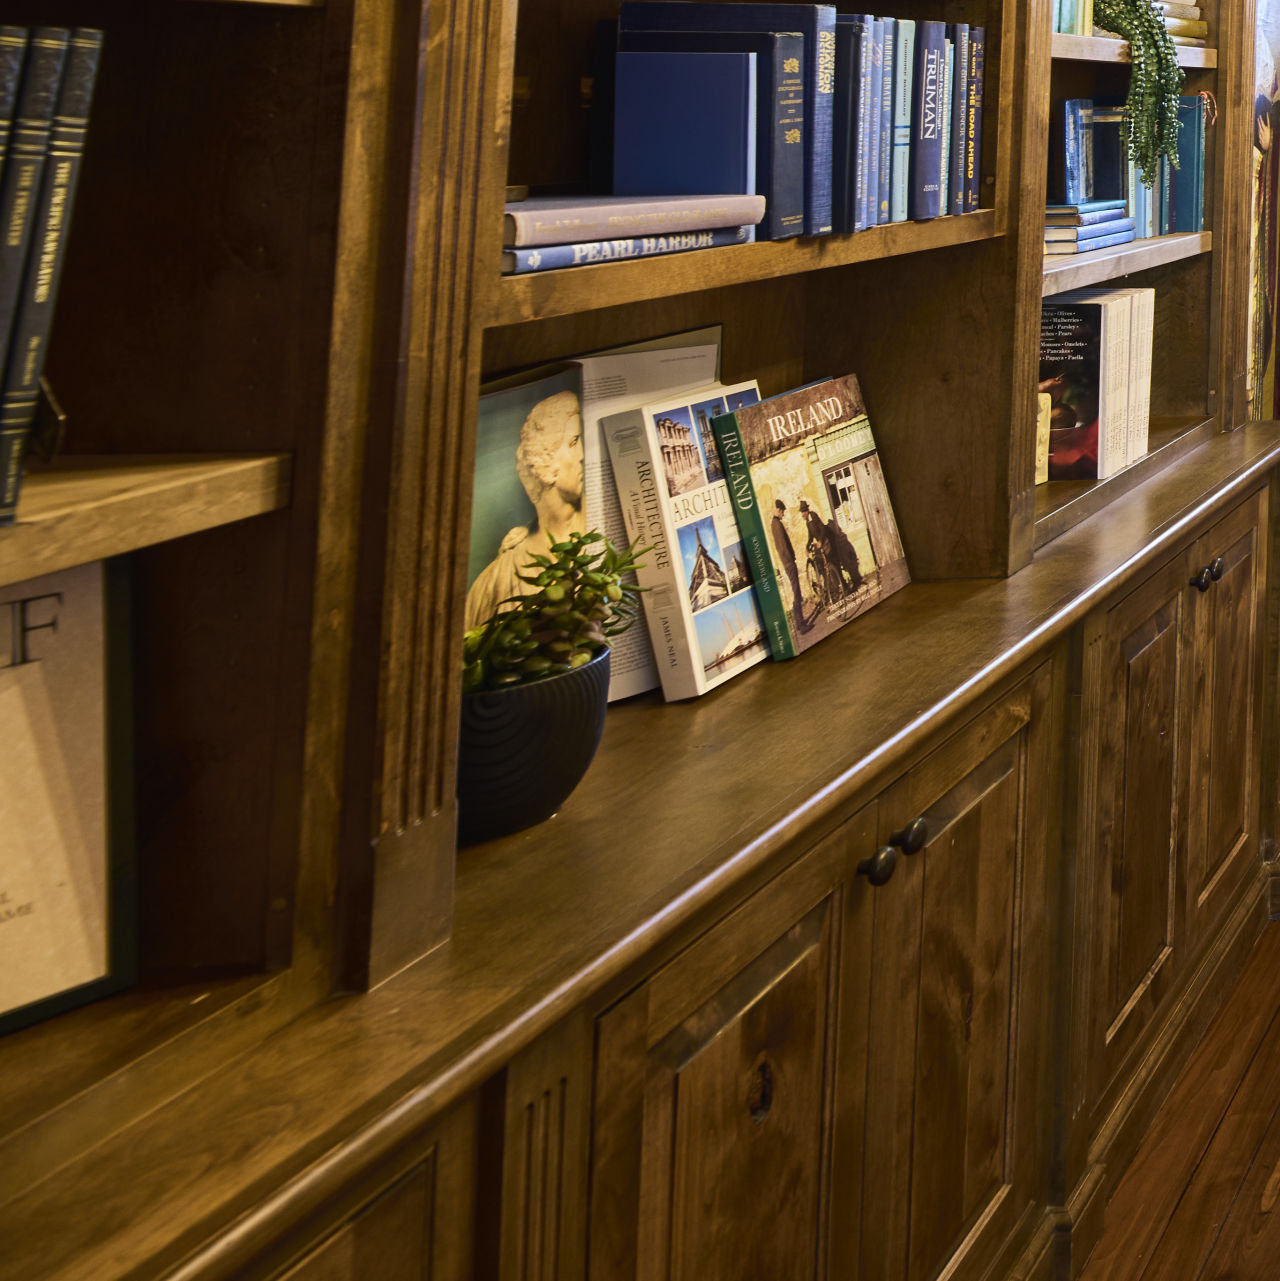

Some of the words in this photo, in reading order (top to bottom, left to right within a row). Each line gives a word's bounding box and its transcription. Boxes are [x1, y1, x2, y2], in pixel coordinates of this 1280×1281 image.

[817, 31, 826, 94] DICTIONARY
[823, 31, 833, 94] AVIATION
[960, 32, 968, 66] DANIELLE
[882, 76, 892, 112] SINATRA
[922, 49, 938, 139] TRUMAN
[960, 69, 968, 91] STEEL
[958, 99, 966, 136] HONOR
[967, 140, 975, 179] AHEAD
[571, 241, 639, 264] PEARL
[641, 232, 714, 253] HARBOR
[767, 397, 843, 442] IRELAND
[721, 431, 753, 511] IRELAND
[636, 460, 670, 570] ARCHITECTURE
[673, 484, 727, 523] ARCHIT
[0, 592, 65, 670] F
[660, 616, 673, 644] JAMES
[667, 646, 678, 670] NEAL
